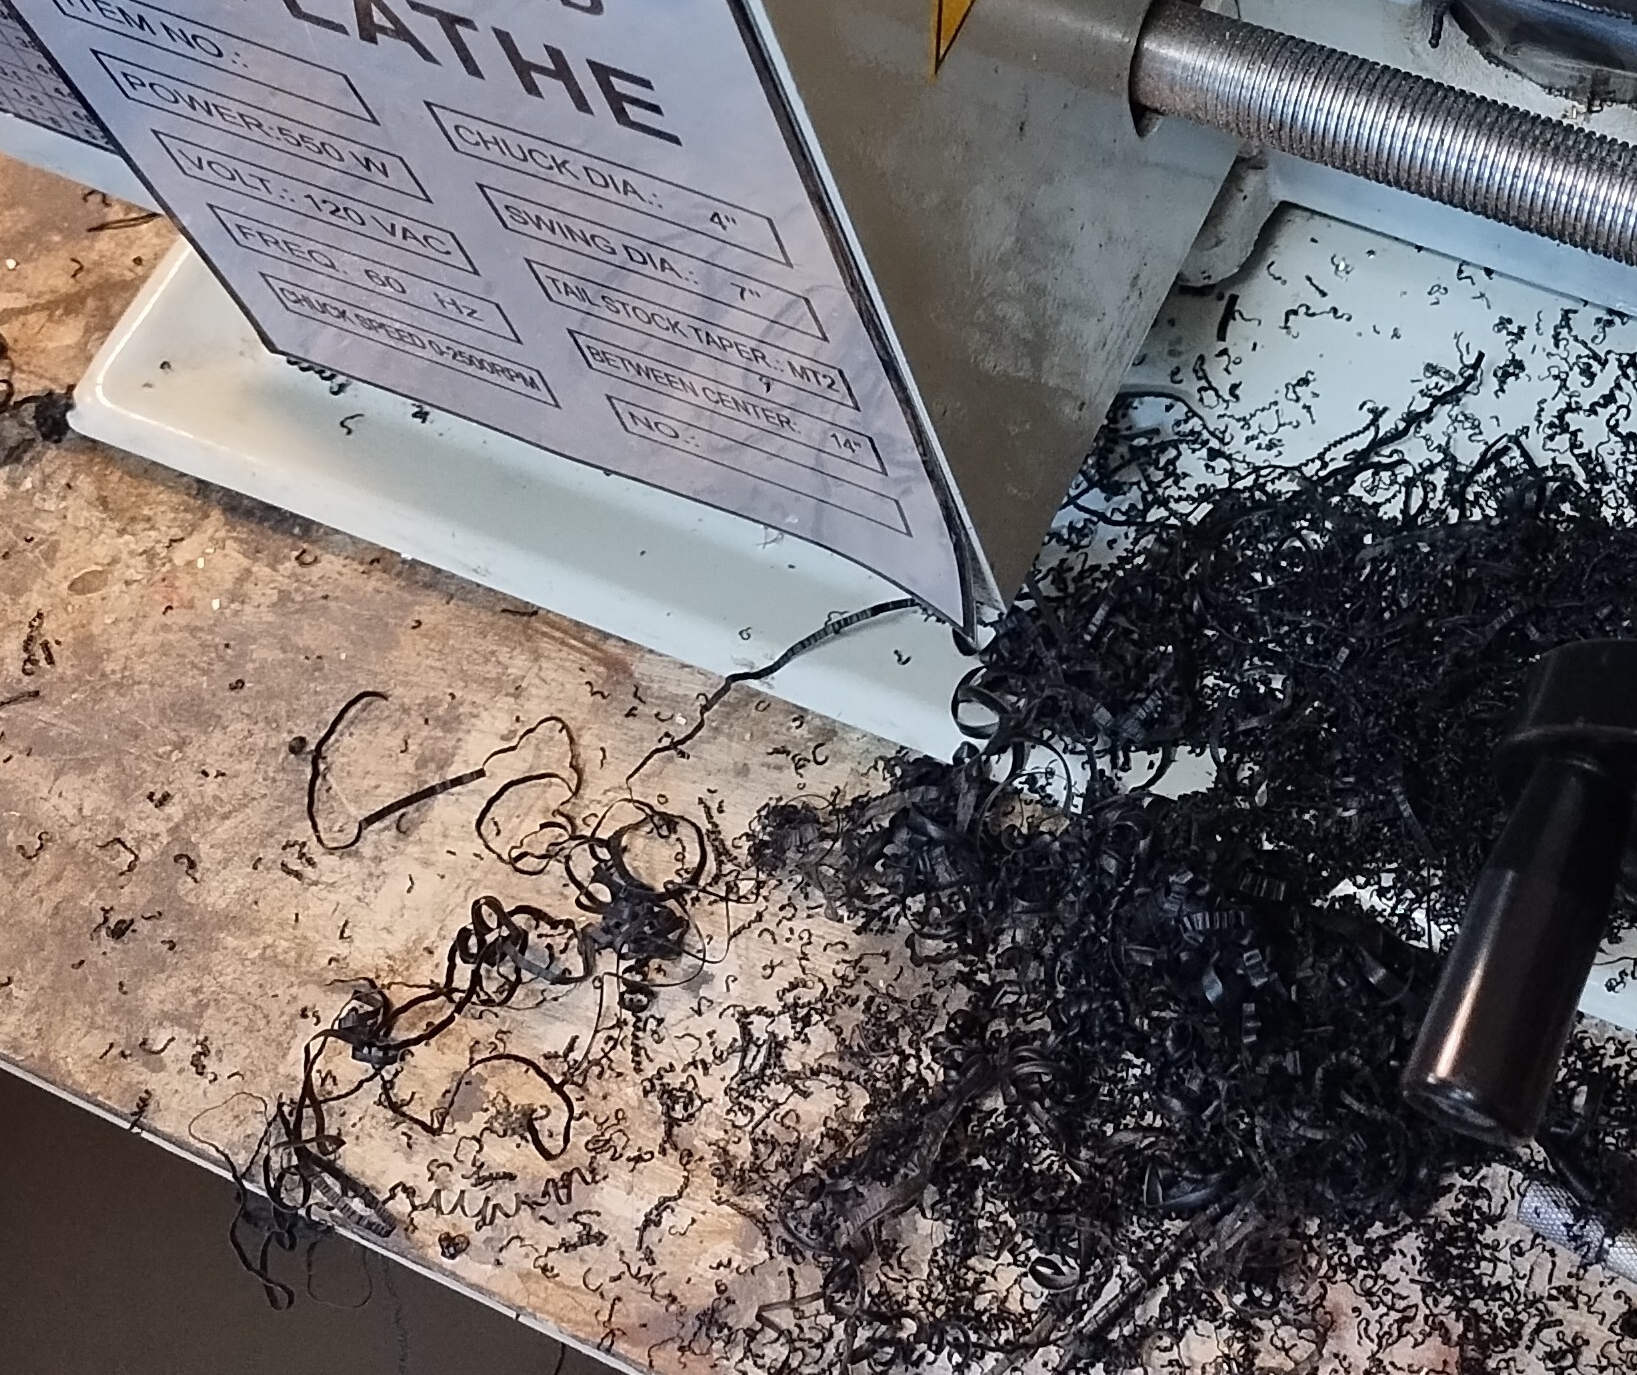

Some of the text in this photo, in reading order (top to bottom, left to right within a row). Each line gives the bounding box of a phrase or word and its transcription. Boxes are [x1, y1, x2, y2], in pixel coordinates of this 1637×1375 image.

[349, 150, 389, 179] W
[454, 124, 580, 180] CHUCK
[304, 193, 367, 227] 120
[371, 214, 452, 256] VAC
[504, 203, 618, 256] SWING
[279, 285, 356, 326] CHUCK
[354, 312, 427, 350] SPEED
[364, 268, 407, 295] 60
[433, 291, 485, 323] Hz
[545, 274, 601, 308] TAIL
[600, 294, 689, 339] STOCK
[787, 360, 841, 394] MT2
[586, 344, 699, 398] BETWEEN
